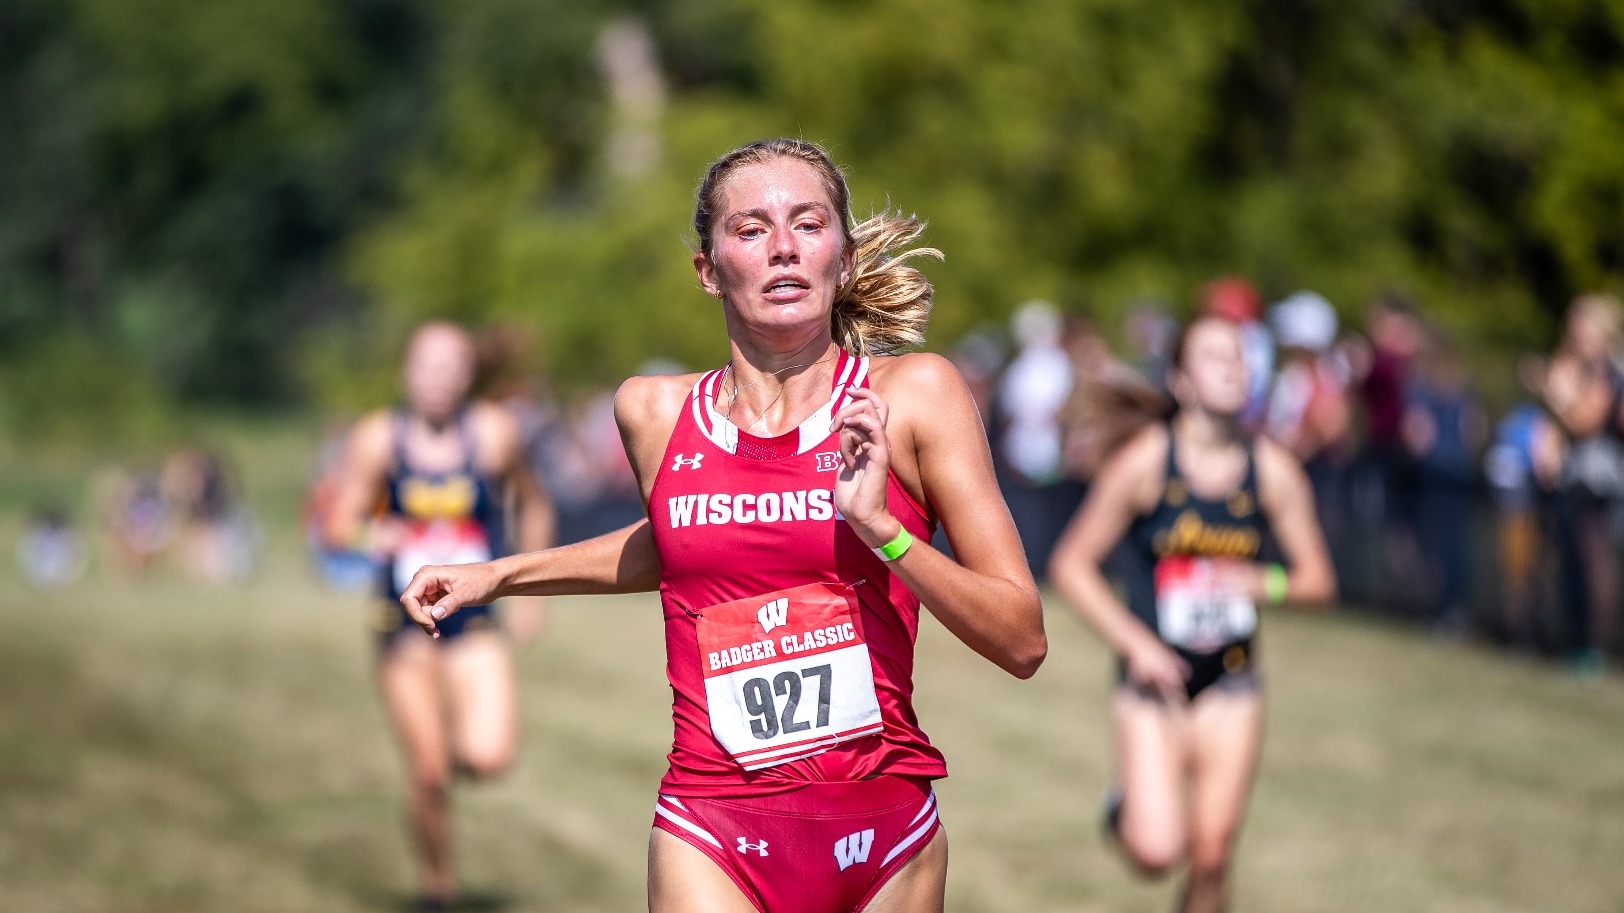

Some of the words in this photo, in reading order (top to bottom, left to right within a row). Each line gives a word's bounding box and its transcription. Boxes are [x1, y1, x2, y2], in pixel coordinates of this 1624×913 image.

[757, 598, 788, 634] W
[708, 639, 777, 670] BADGER
[780, 622, 855, 655] CLASSIC
[743, 664, 832, 740] 927
[834, 828, 875, 871] W
